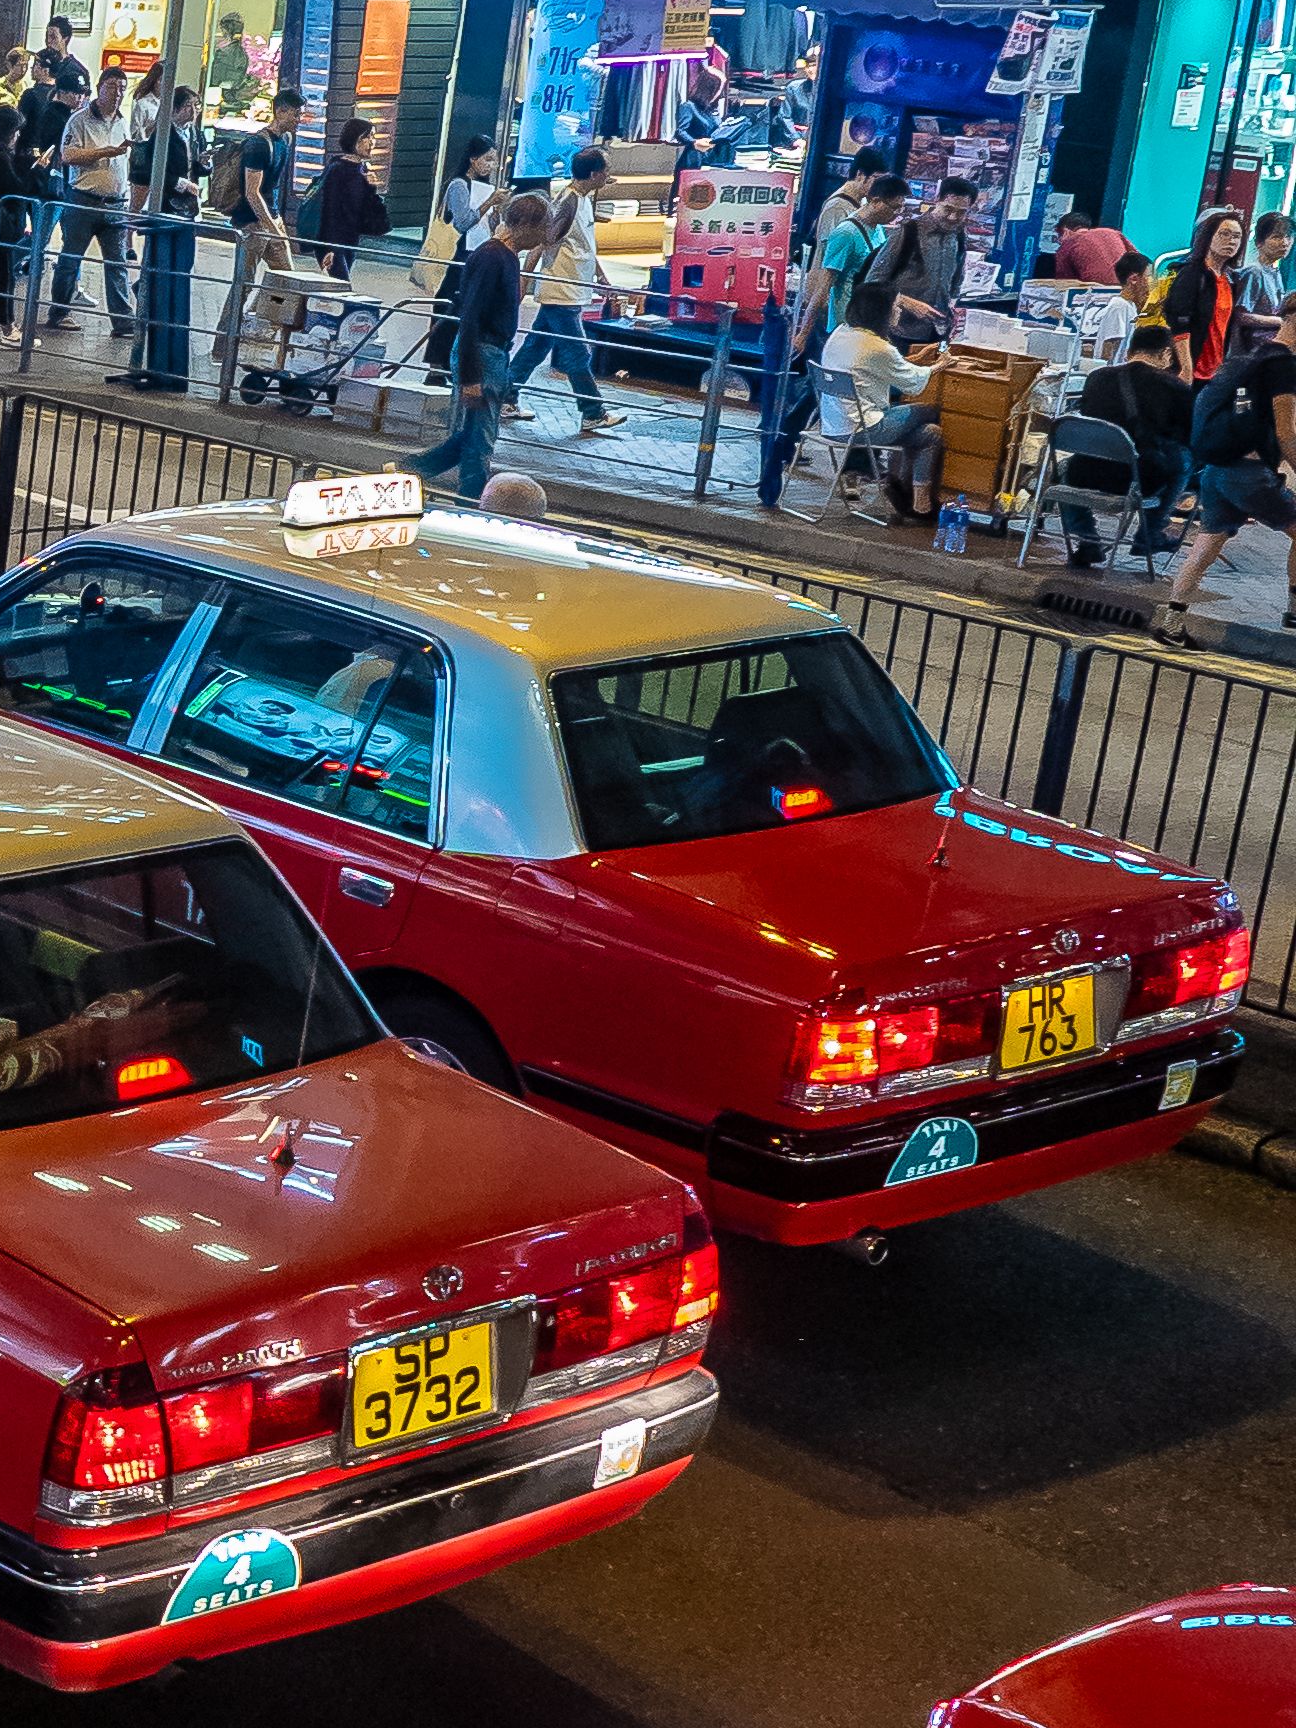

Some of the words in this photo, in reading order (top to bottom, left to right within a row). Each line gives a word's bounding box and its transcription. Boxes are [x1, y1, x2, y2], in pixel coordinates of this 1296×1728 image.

[549, 46, 581, 76] 7折
[542, 84, 576, 113] 8折
[719, 184, 789, 205] 高價回收
[319, 477, 411, 515] TAXI
[1027, 982, 1070, 1024] HR
[1017, 1014, 1080, 1064] 763
[921, 1120, 959, 1138] TAXI
[927, 1134, 947, 1159] 4
[905, 1155, 960, 1178] SEATS
[394, 1338, 452, 1387] SP
[364, 1365, 483, 1440] 3732
[223, 1554, 253, 1586] 4
[192, 1580, 274, 1614] SEATS
